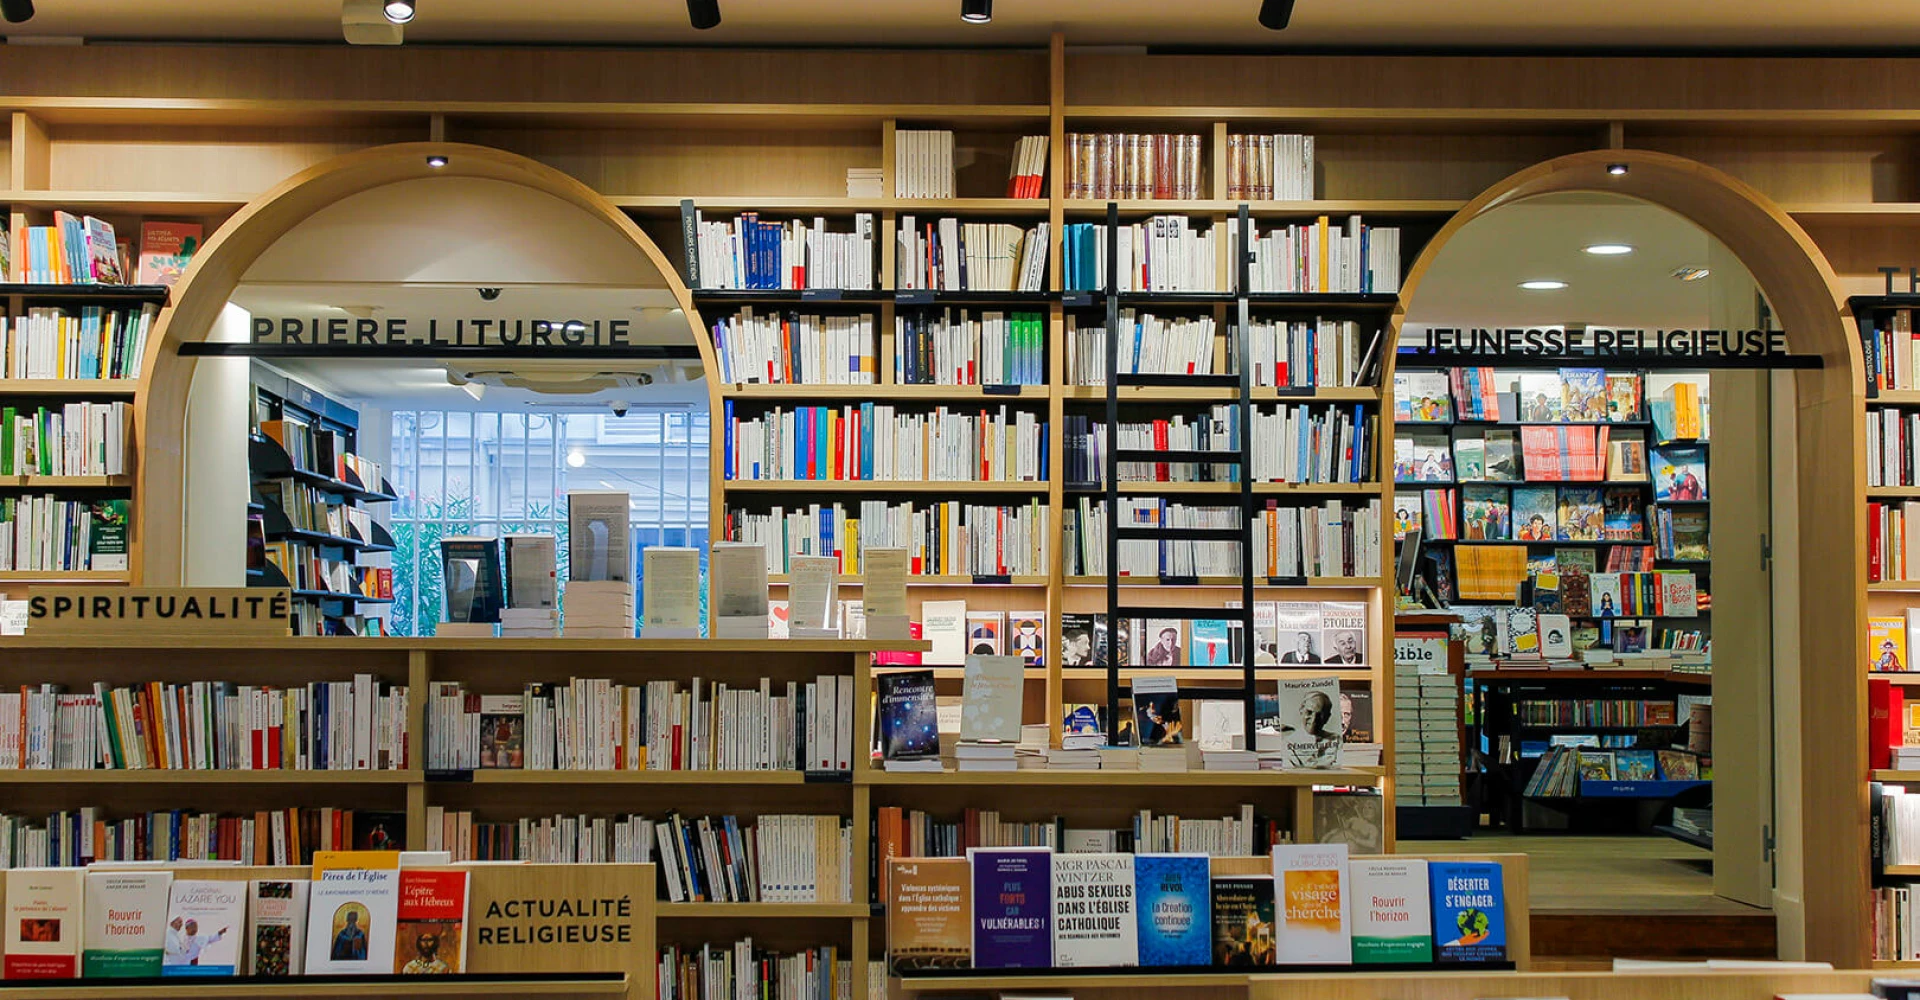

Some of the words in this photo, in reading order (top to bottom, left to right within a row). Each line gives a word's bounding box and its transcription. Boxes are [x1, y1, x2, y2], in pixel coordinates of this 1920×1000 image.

[1418, 329, 1585, 356] JEUNESSE
[1594, 330, 1786, 357] RELIGIEUSE
[30, 592, 287, 619] SPIRITUALITÉ
[893, 685, 934, 695] Rencontre
[1055, 861, 1084, 872] MGR
[1086, 859, 1129, 871] PASCAL
[322, 871, 344, 881] Pères
[346, 871, 355, 881] de
[358, 870, 388, 883] l'Église
[1055, 872, 1114, 883] WINTZER
[1160, 883, 1184, 893] REVOL
[1447, 876, 1489, 891] DÉSERTER
[1057, 885, 1085, 899] ABUS
[1088, 884, 1132, 898] SEXUELS
[1292, 888, 1337, 903] visage
[175, 894, 213, 904] LAZARE
[216, 894, 237, 904] YOU
[1372, 896, 1405, 907] Rouvrir
[1445, 894, 1493, 908] S'ENGAGER
[485, 895, 631, 919] ACTUALITÉ
[1057, 902, 1086, 915] DANS
[1088, 899, 1130, 914] L'ÉGLISE
[1151, 902, 1160, 913] La
[1285, 905, 1341, 919] cherche
[108, 909, 143, 921] Rouvrir
[1370, 911, 1409, 922] l'horizon
[105, 923, 145, 935] l'horizon
[981, 917, 1040, 930] VULNÉRABLES
[1058, 917, 1121, 931] CATHOLIQUE
[478, 925, 631, 944] RELIGIEUSE
